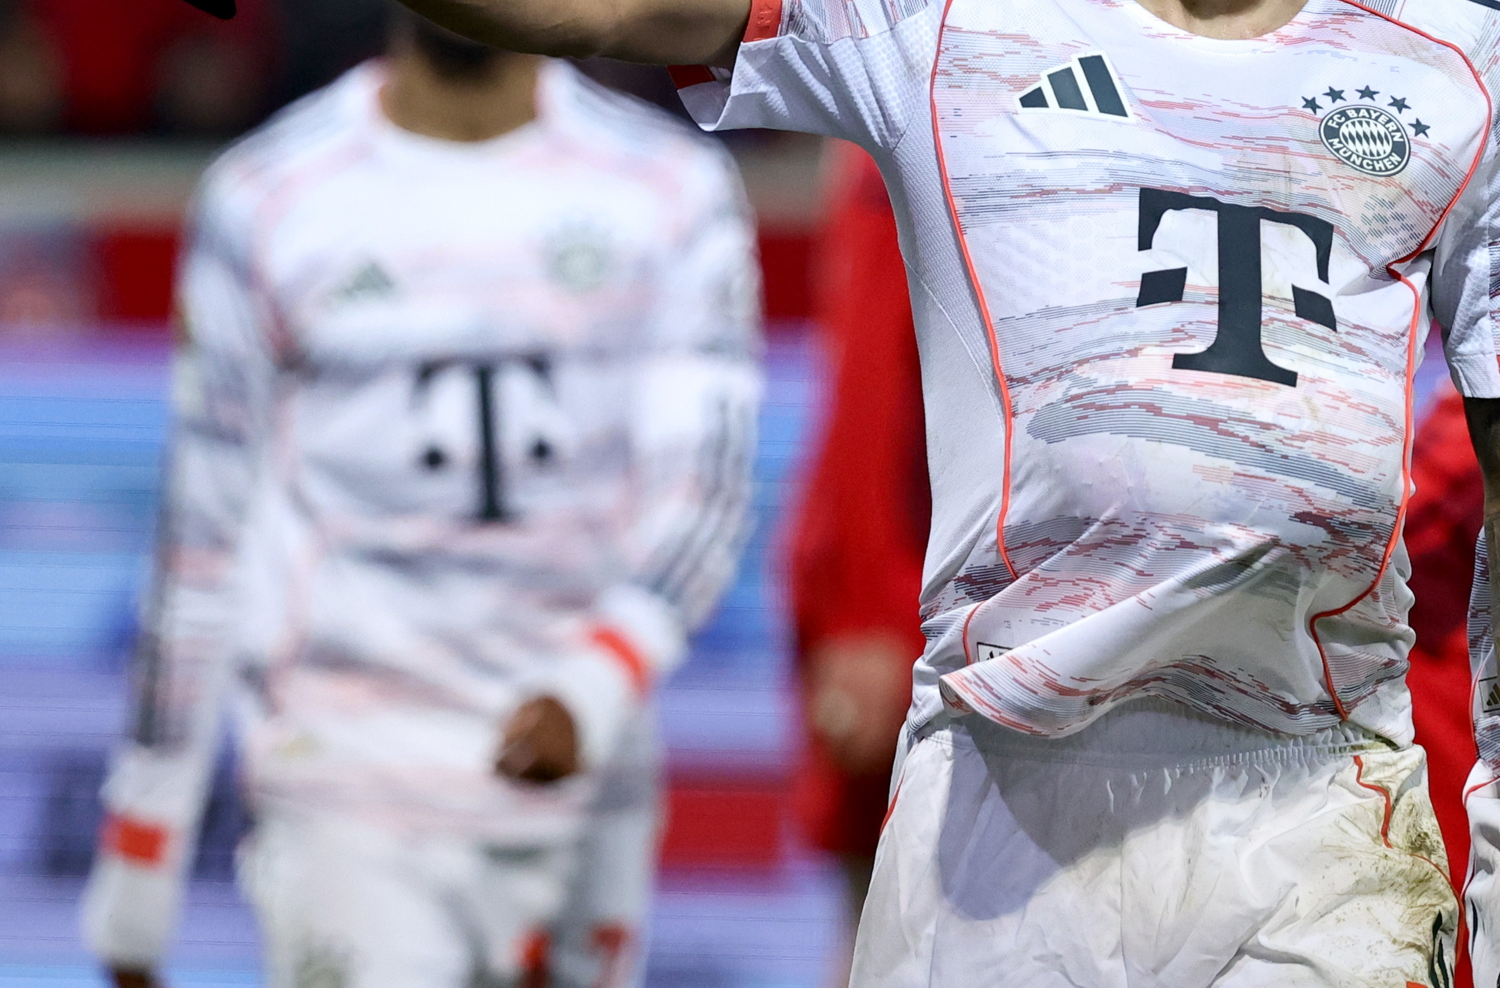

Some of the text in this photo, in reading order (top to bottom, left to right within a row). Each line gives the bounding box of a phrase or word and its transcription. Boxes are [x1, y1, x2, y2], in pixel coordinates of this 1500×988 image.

[1327, 108, 1405, 143] FC BAYERN
[1327, 137, 1403, 172] MÜNCHEN
[1135, 186, 1338, 388] T
[408, 350, 560, 526] T
